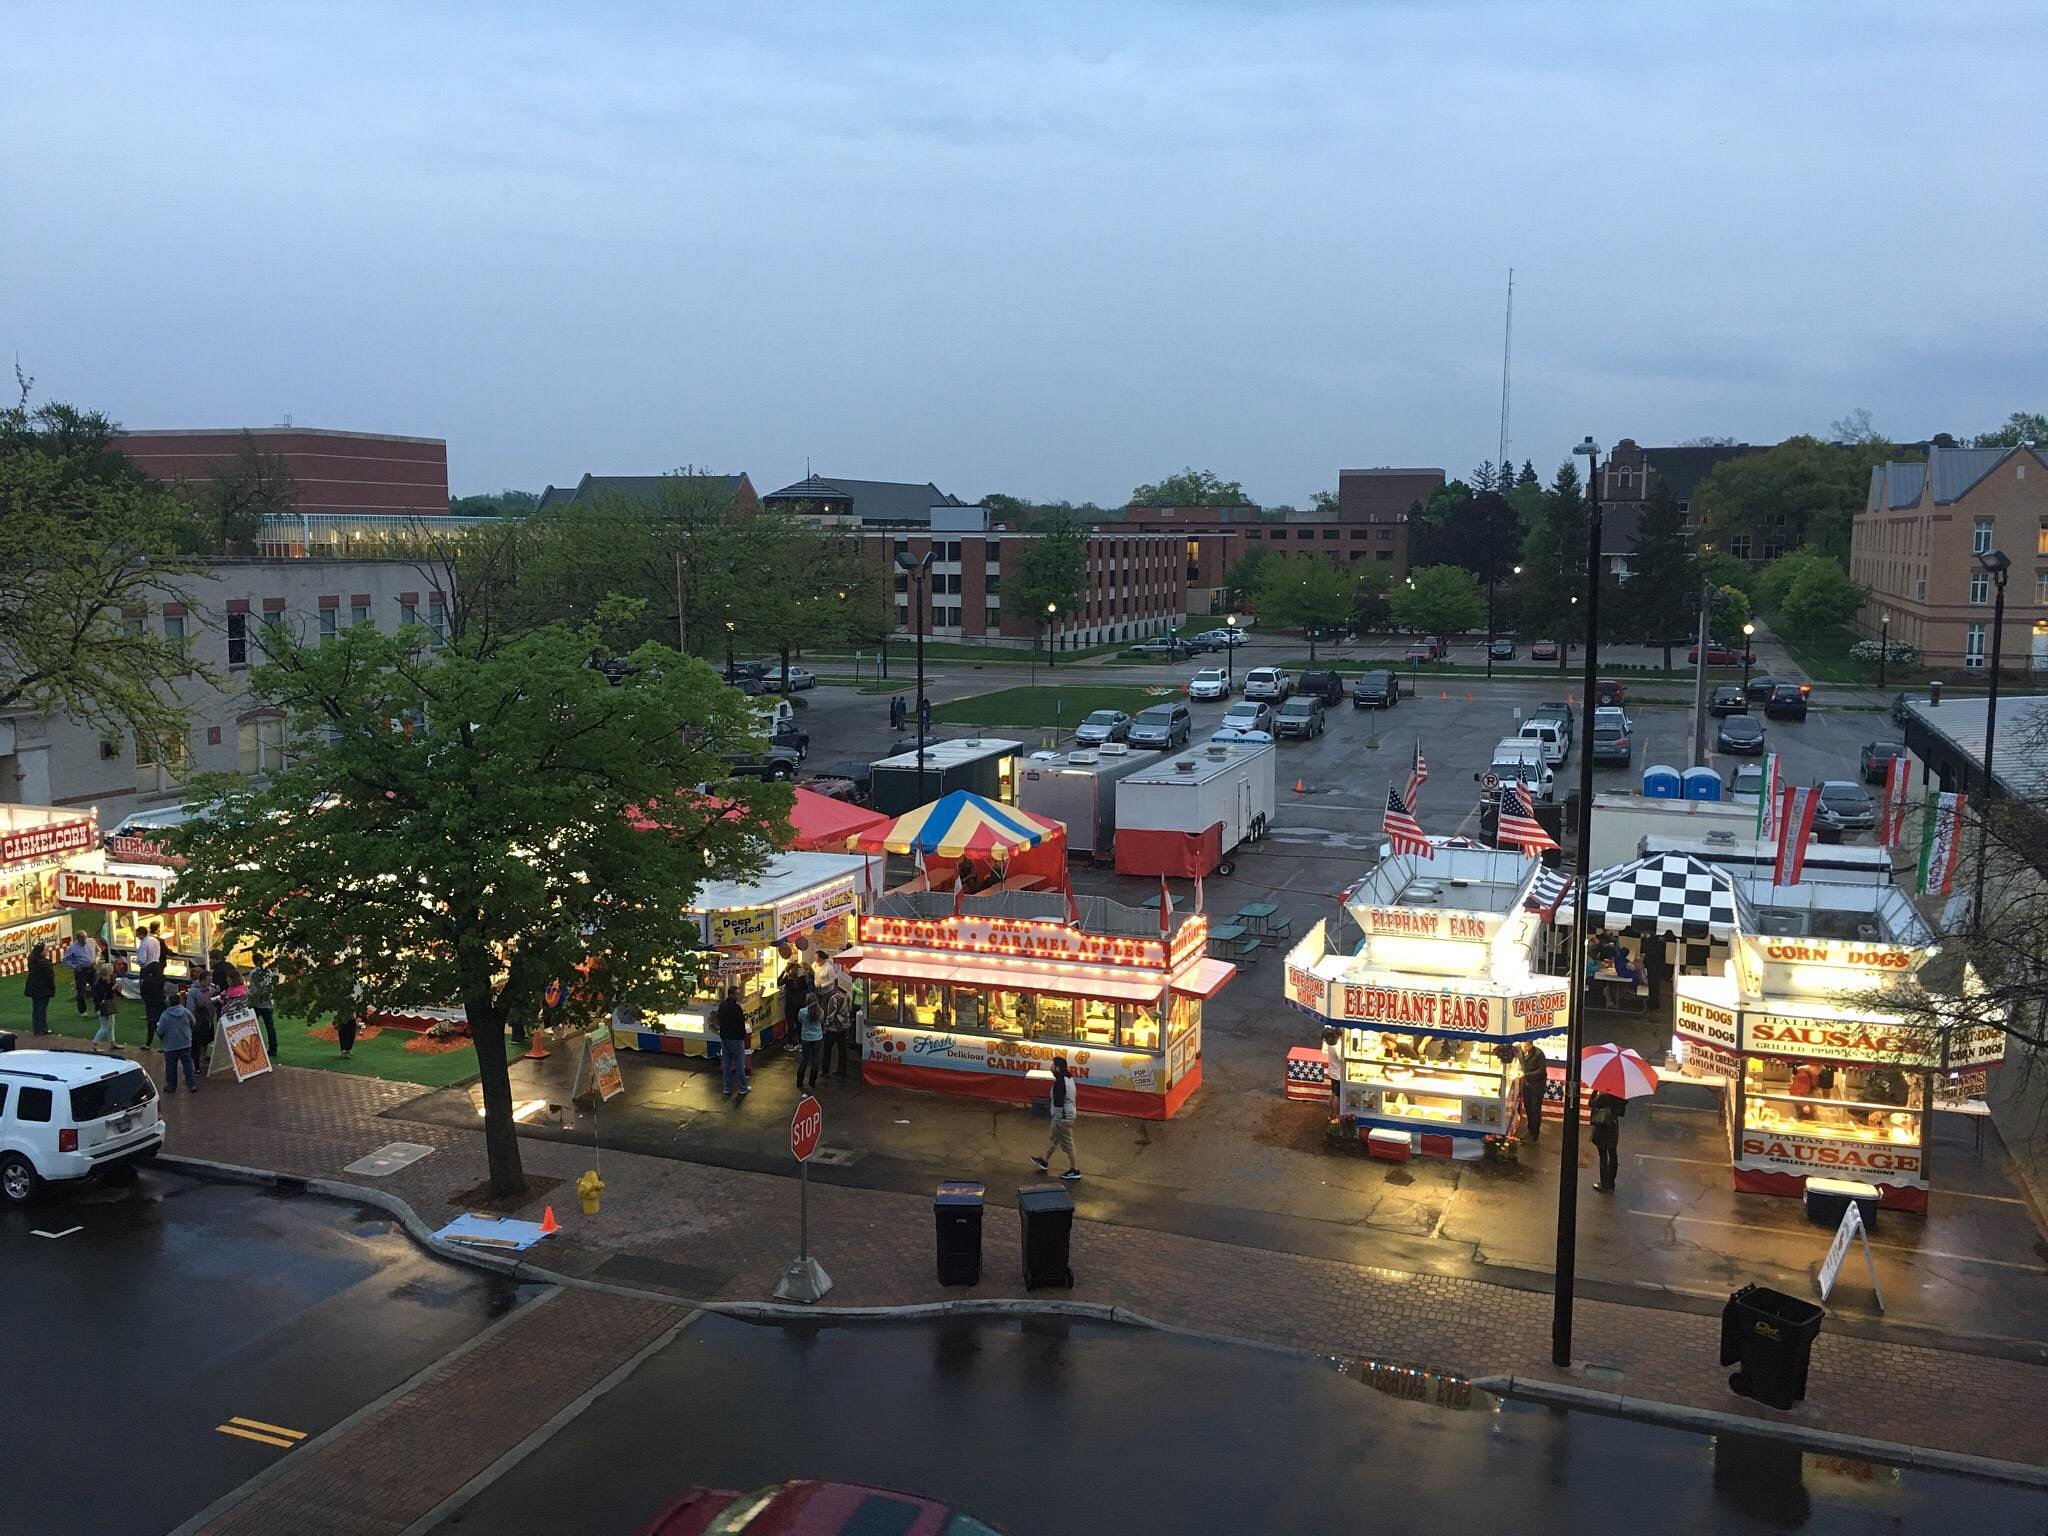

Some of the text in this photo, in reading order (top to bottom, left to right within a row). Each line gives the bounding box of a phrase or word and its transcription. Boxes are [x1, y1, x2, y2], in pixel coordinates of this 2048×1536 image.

[4, 826, 88, 859] CARMELCORN
[65, 875, 156, 904] Elephant Ears
[723, 918, 751, 928] Deep
[733, 922, 764, 936] Fried!
[779, 905, 818, 931] FUNNEL
[1371, 910, 1486, 939] ELEPHANT EARS
[5, 922, 57, 943] POP CORN
[882, 925, 1145, 959] POPCORN CARAMEL APPLES
[1767, 946, 1909, 968] CORN DOGS
[1344, 986, 1489, 1031] ELEPHANT EARS
[1513, 992, 1566, 1016] TAKE SOME
[1682, 1002, 1733, 1026] HOT DOGS
[1525, 1012, 1554, 1030] HOME
[1678, 1017, 1735, 1043] CORN DOGS
[1763, 1016, 1835, 1029] ITALIAN
[913, 1035, 956, 1055] Fresh
[947, 1050, 984, 1061] Delicious
[987, 1041, 1091, 1064] POPCORN &
[1756, 1042, 1805, 1053] GRILLED
[1979, 1043, 2003, 1057] DOGS
[1690, 1046, 1709, 1060] STEAK
[1715, 1053, 1740, 1068] CHEESE
[1690, 1057, 1739, 1079] ONION RINGS
[793, 1112, 820, 1146] STOP
[1769, 1133, 1824, 1146] ITALIAN
[1842, 1140, 1893, 1153] POLISH
[1743, 1138, 1919, 1172] SAUSAGE
[1769, 1157, 1806, 1167] GRILLED
[1809, 1161, 1849, 1171] PEPPERS
[1860, 1167, 1895, 1177] ONIONS
